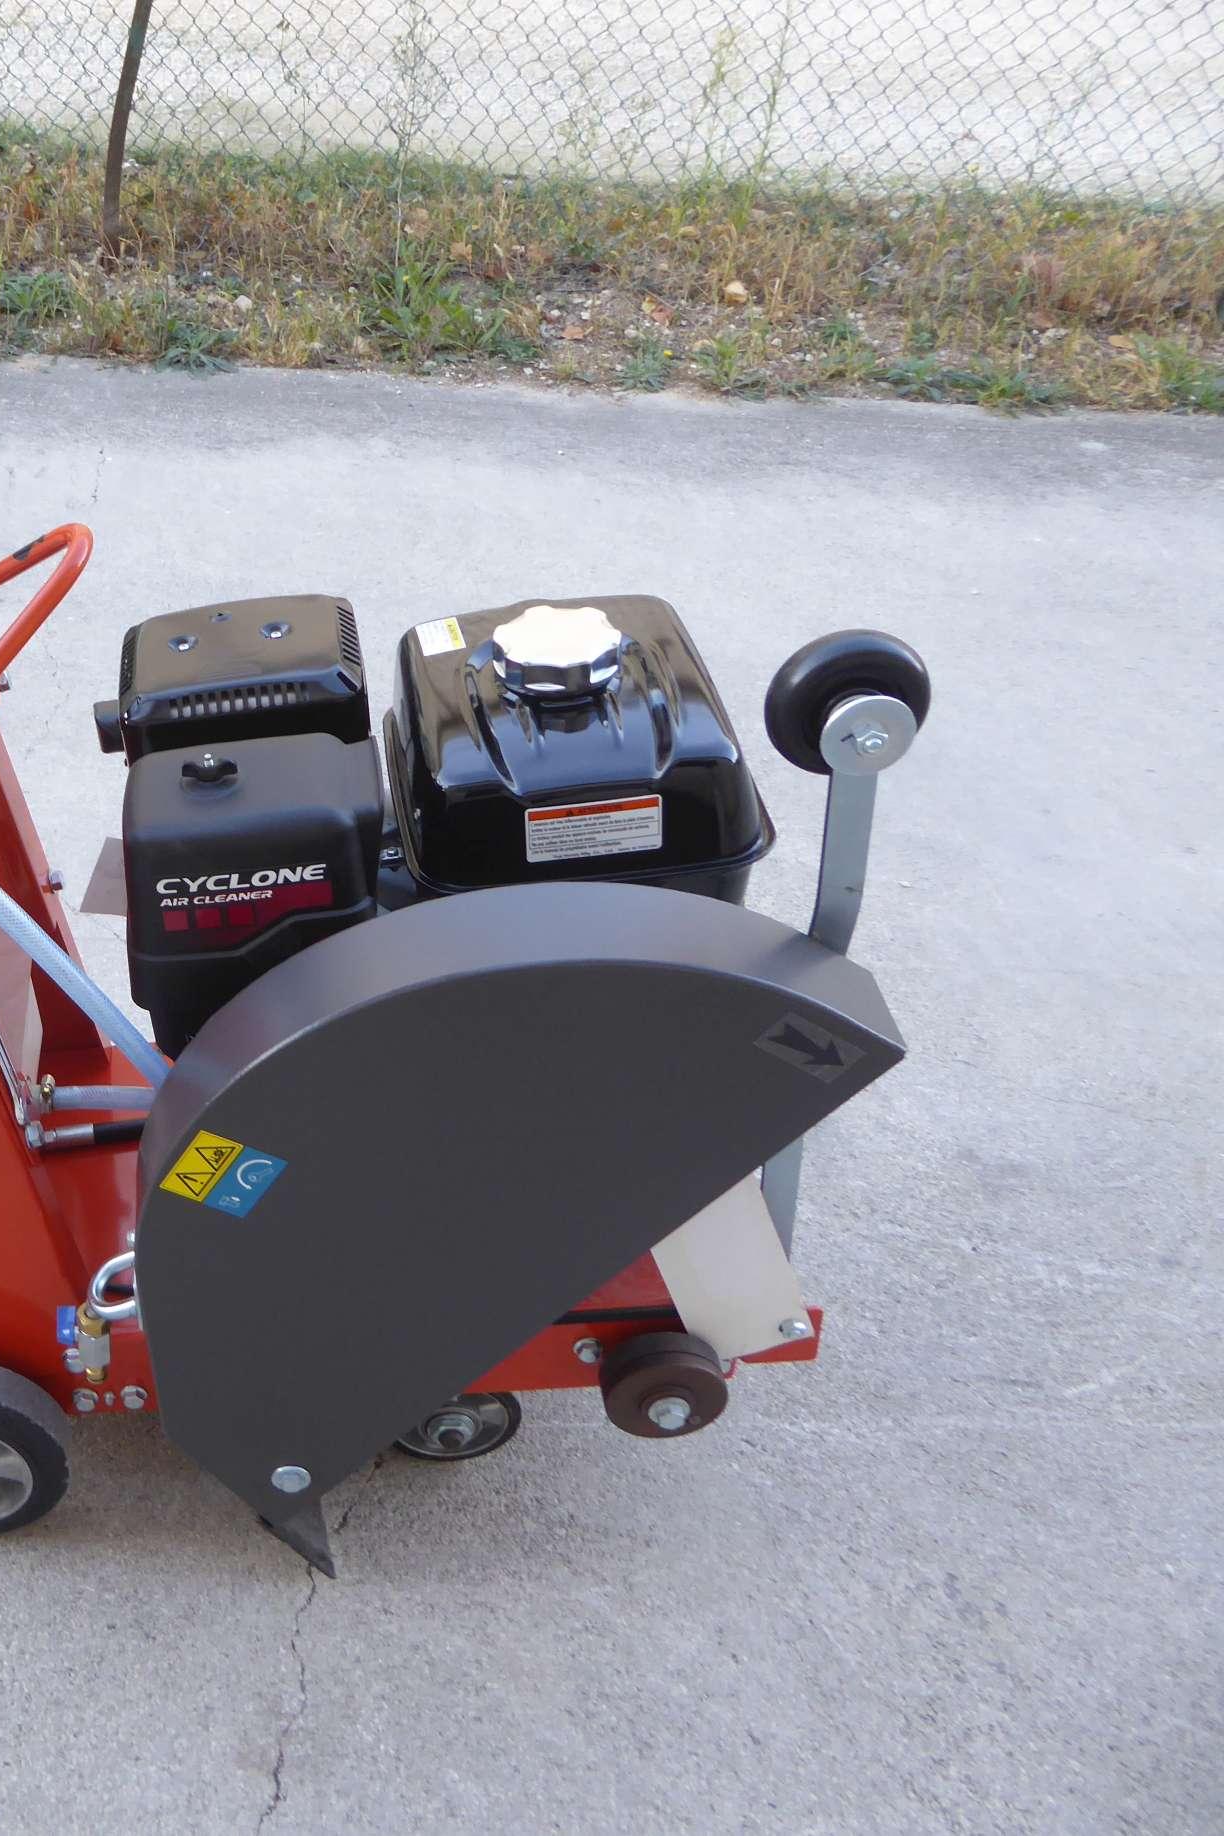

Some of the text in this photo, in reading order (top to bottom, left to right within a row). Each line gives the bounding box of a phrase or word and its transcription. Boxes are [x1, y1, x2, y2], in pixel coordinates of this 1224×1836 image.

[156, 864, 326, 895] CYCLONE
[160, 890, 273, 907] AIR CLEANER
